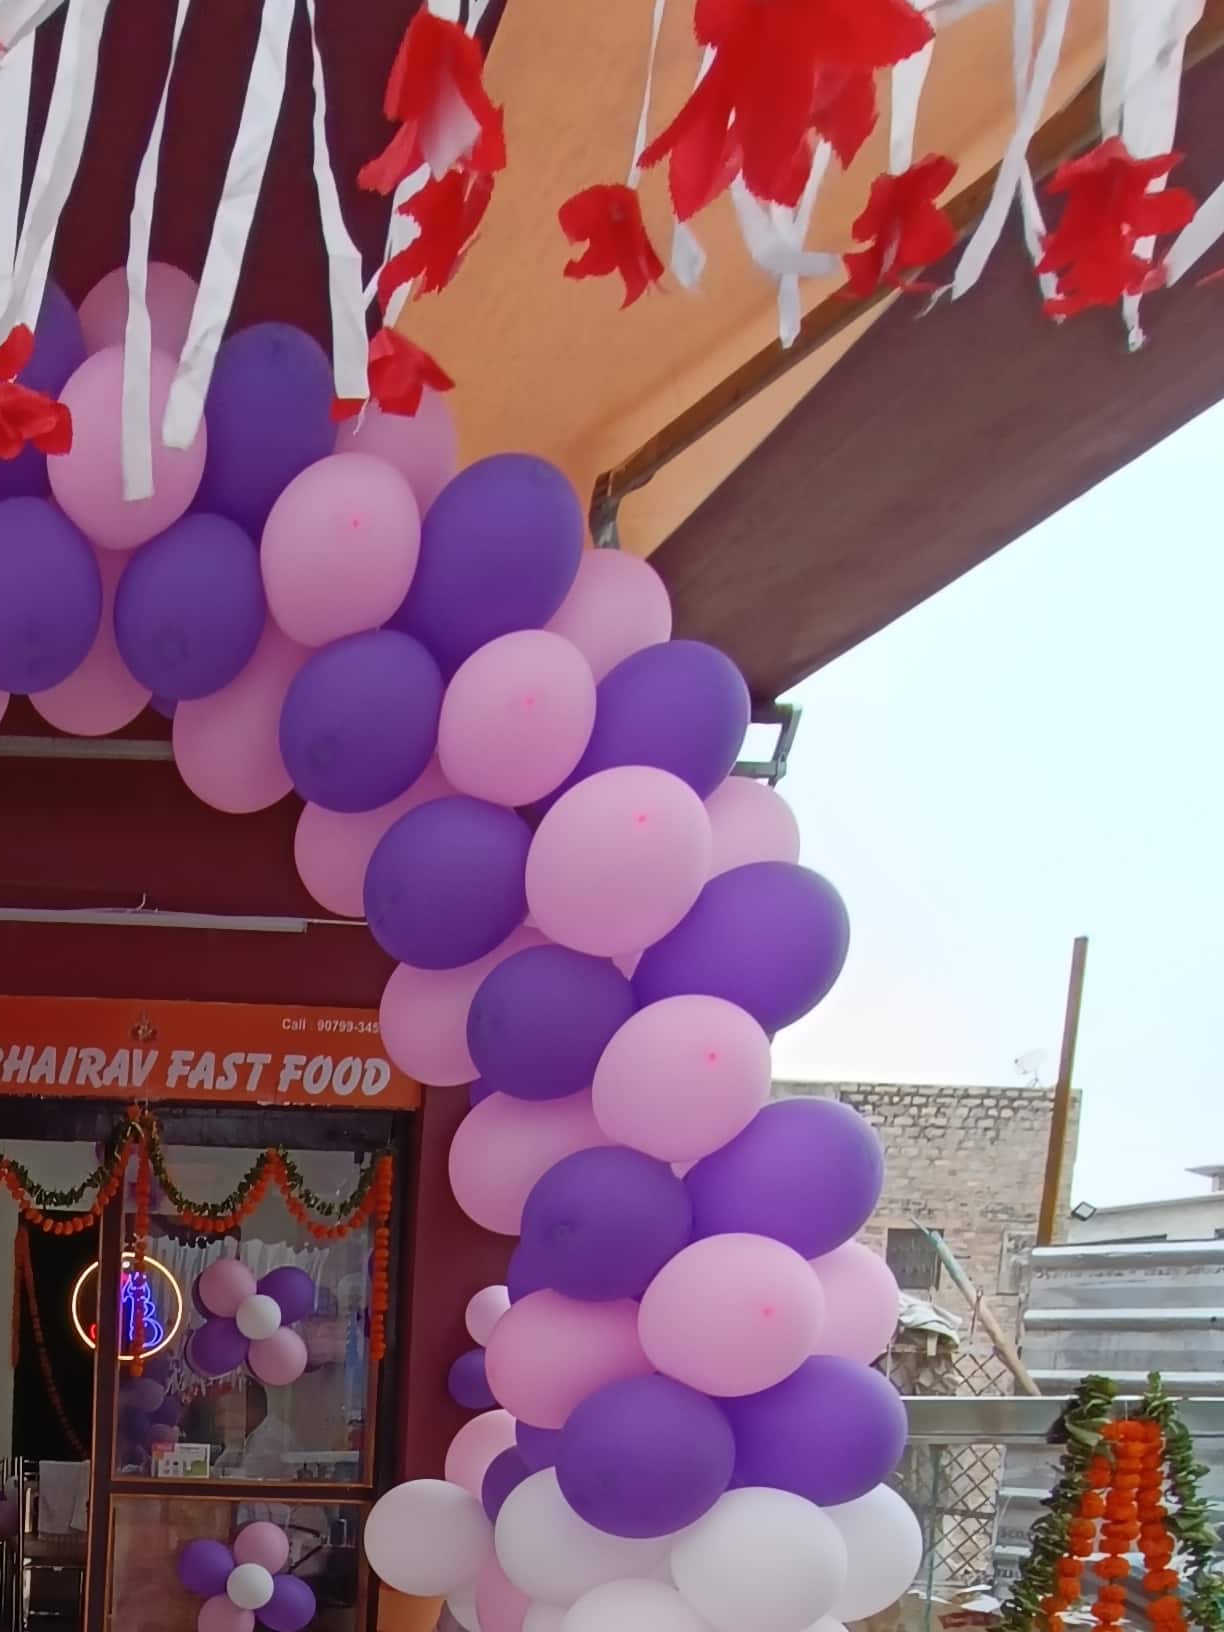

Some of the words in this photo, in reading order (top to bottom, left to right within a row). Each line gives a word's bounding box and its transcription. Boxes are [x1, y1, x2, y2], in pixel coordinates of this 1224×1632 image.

[282, 1018, 306, 1030] Call
[166, 1049, 273, 1092] FAST
[278, 1054, 391, 1096] FOOD
